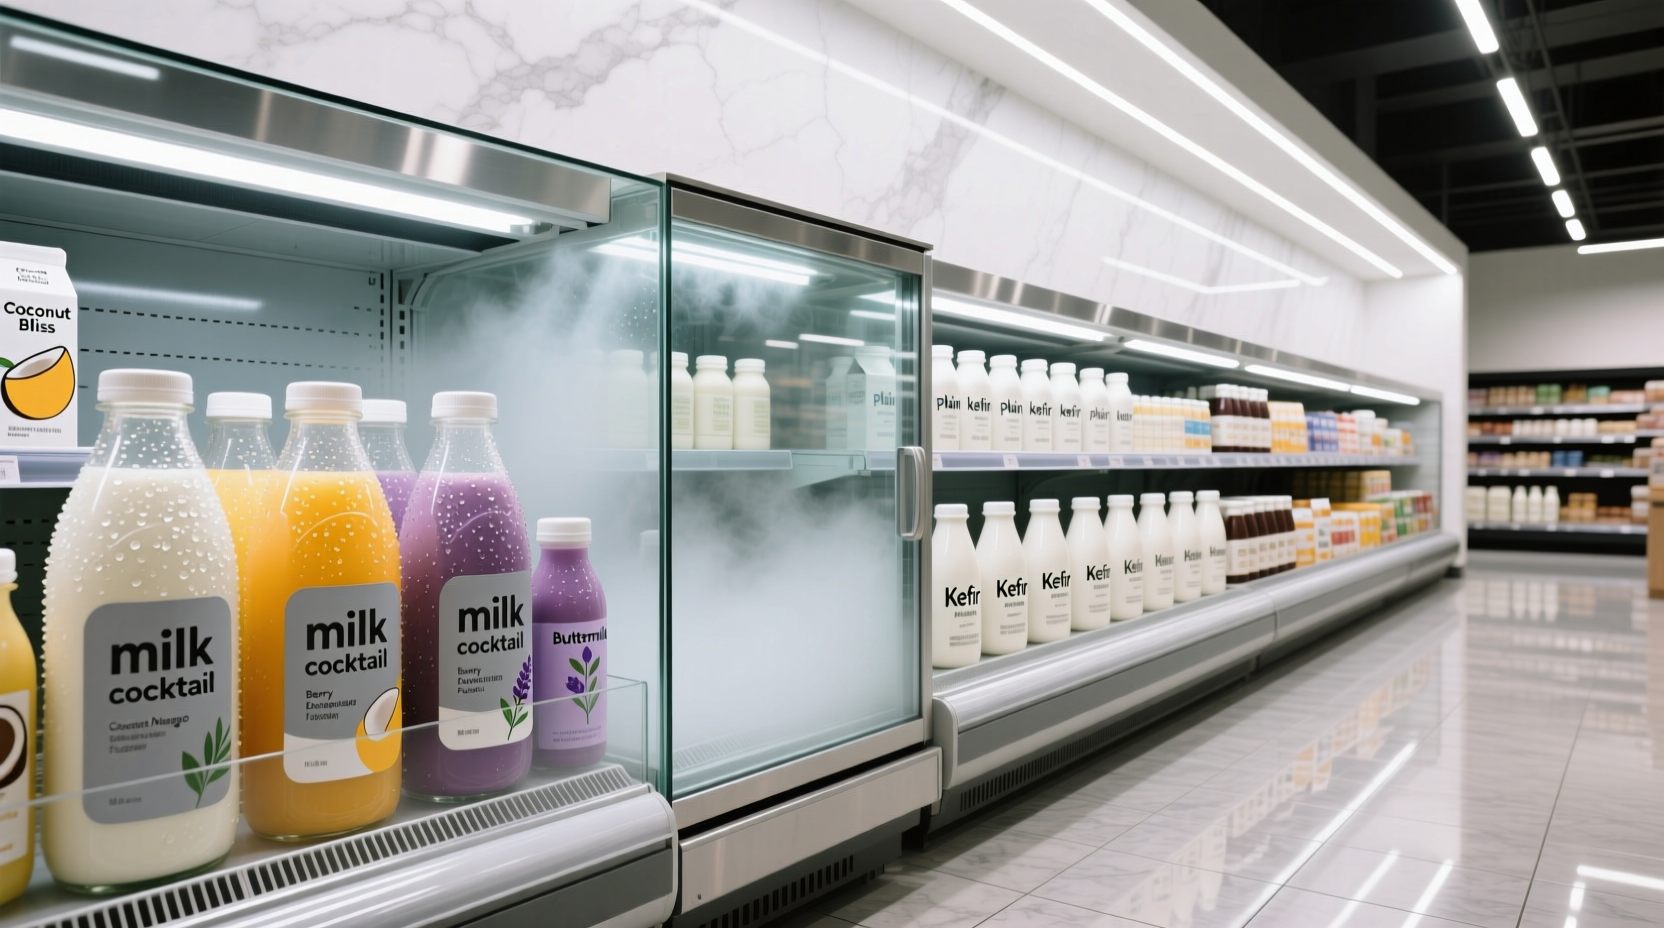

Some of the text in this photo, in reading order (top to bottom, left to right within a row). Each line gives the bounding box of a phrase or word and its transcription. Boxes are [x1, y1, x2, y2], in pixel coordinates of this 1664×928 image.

[4, 301, 72, 320] Coconut
[19, 318, 56, 334] Bliss
[996, 577, 1028, 599] Kefir
[1042, 570, 1071, 590] Kefir
[945, 584, 981, 608] Kefir
[458, 594, 525, 633] milk
[306, 607, 388, 651] milk
[111, 626, 214, 675] milk
[457, 631, 524, 656] cocktail
[305, 647, 388, 677] cocktail
[109, 670, 215, 705] cocktail
